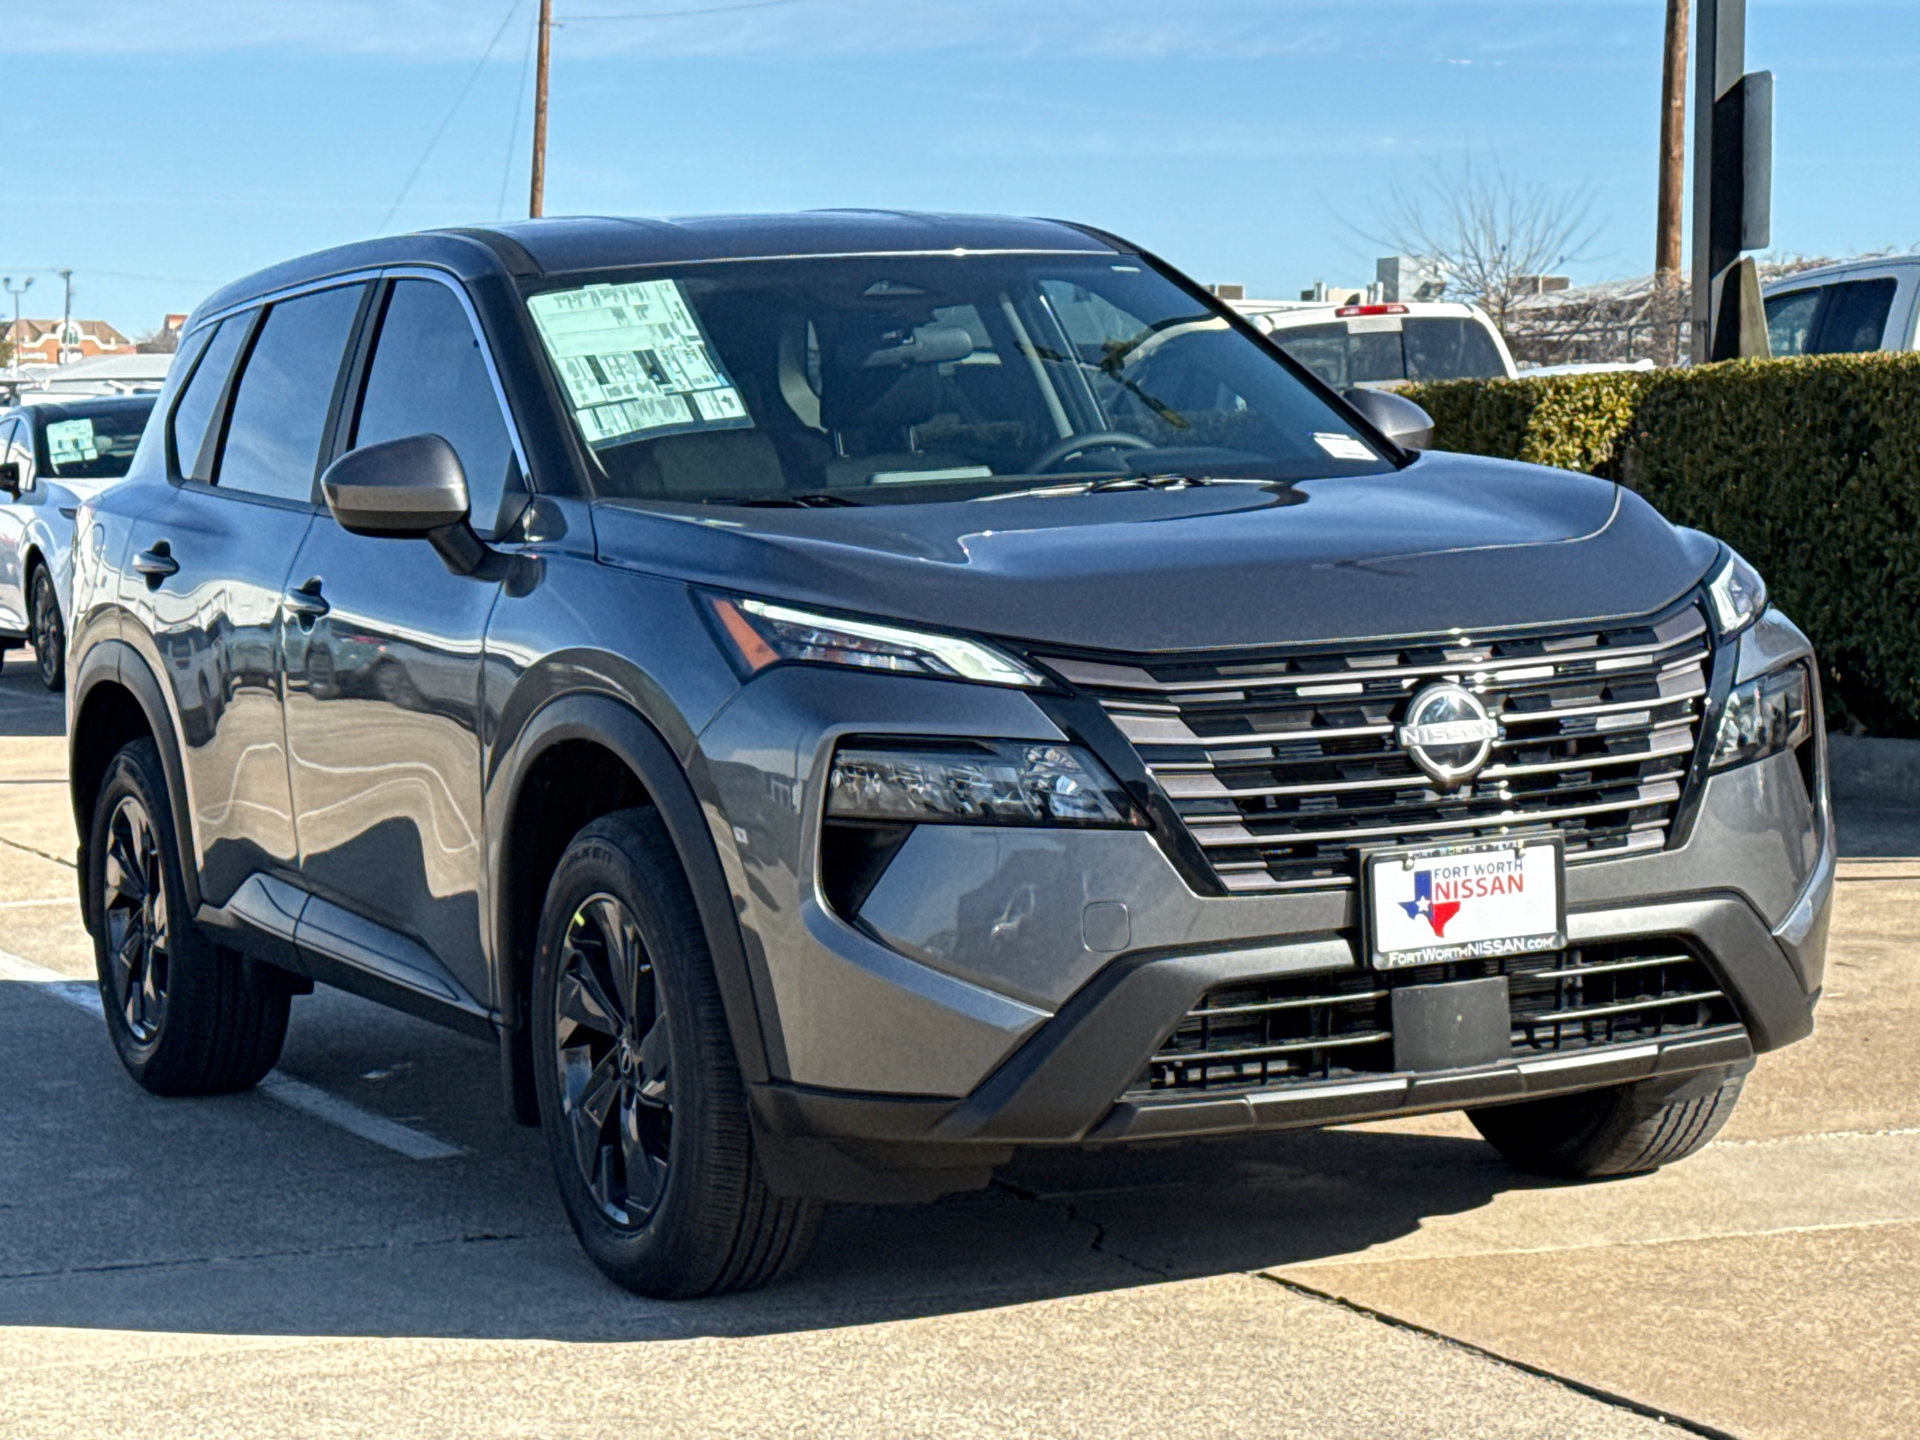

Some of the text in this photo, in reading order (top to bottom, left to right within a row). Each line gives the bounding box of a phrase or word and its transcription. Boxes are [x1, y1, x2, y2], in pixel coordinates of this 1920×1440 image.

[1402, 723, 1495, 745] NISSAN
[1434, 860, 1523, 879] FORT WORTH
[1435, 873, 1524, 901] NISSAN
